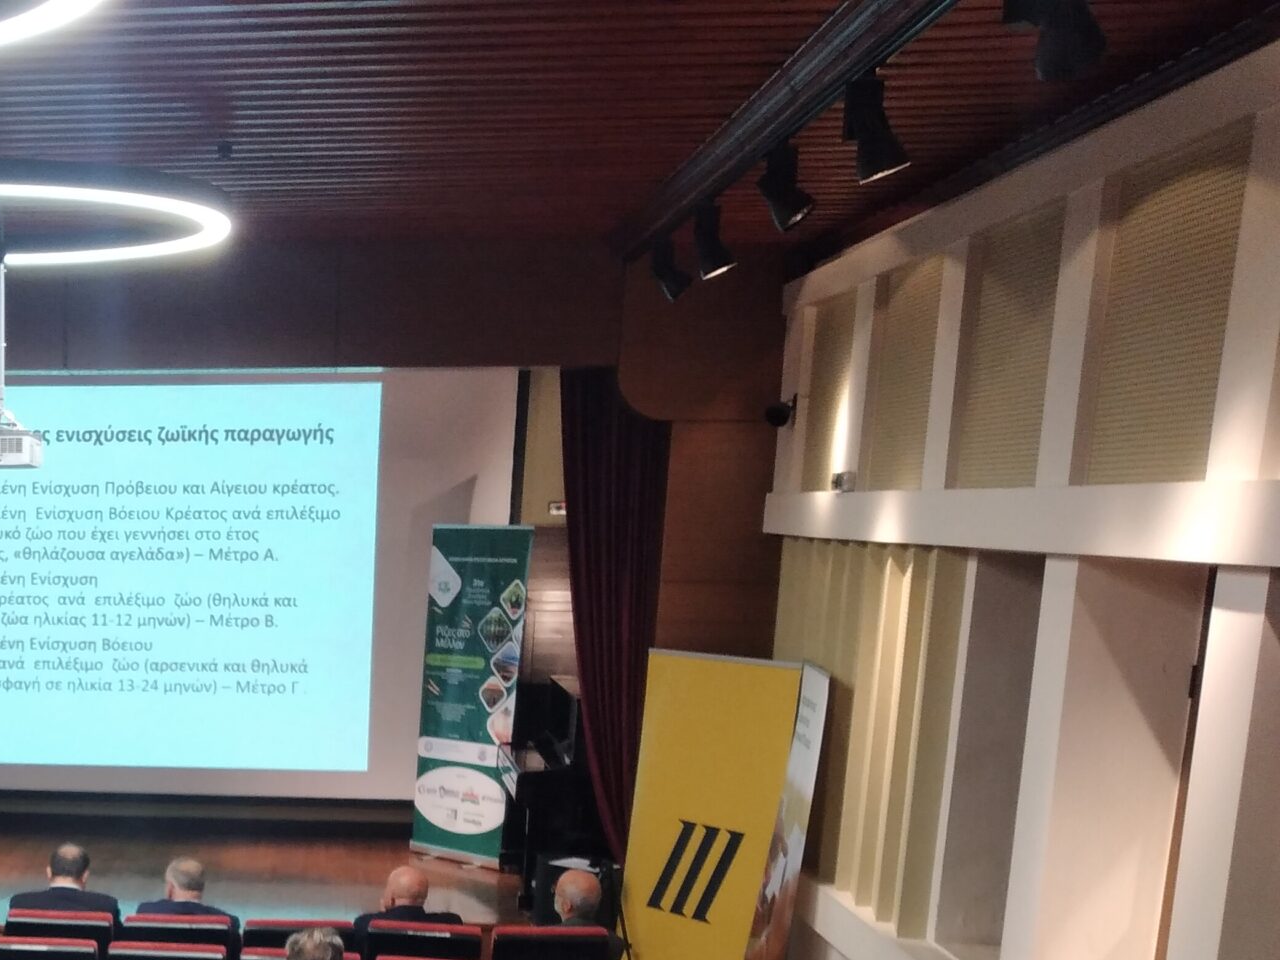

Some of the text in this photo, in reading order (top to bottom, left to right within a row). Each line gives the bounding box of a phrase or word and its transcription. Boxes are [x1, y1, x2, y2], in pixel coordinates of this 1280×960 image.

[56, 425, 152, 445] ενισχύσεις
[157, 424, 219, 445] ζωϊκής
[224, 423, 334, 445] παραγωγής
[32, 480, 99, 497] Ενίσχυση
[105, 480, 177, 497] Πρόβειου
[182, 483, 206, 494] και
[210, 480, 267, 497] Αίγειου
[272, 479, 339, 497] κρέατος.
[35, 506, 103, 523] Ενίσχυση
[108, 506, 160, 521] Βόειου
[166, 505, 228, 522] Κρέατος
[232, 505, 261, 520] ανά
[266, 505, 341, 523] επιλέξιμο
[25, 525, 53, 542] ζώο
[57, 529, 86, 540] που
[91, 526, 119, 543] έχει
[124, 526, 190, 543] γεννήσει
[195, 529, 221, 541] στο
[226, 527, 259, 543] έτος
[14, 546, 105, 563] «θηλάζουσα
[110, 546, 190, 564] αγελάδα»)
[208, 547, 259, 564] Μέτρο
[30, 572, 98, 588] Ενίσχυση
[57, 591, 86, 606] ανά
[94, 592, 165, 609] επιλέξιμο
[174, 593, 202, 608] ζώο
[207, 593, 269, 609] (θηλυκά
[274, 596, 298, 608] και
[1, 611, 28, 626] ζώα
[33, 611, 86, 628] ηλικίας
[92, 613, 133, 626] 11-12
[137, 612, 191, 629] μηνών)
[209, 613, 260, 630] Μέτρο
[29, 636, 97, 653] Ενίσχυση
[102, 637, 153, 652] Βόειου
[34, 656, 103, 673] επιλέξιμο
[112, 657, 139, 672] ζώο
[144, 657, 218, 674] (αρσενικά
[223, 661, 247, 673] και
[251, 658, 308, 675] θηλυκά
[45, 679, 62, 690] σε
[67, 677, 112, 693] ηλικία
[118, 679, 159, 692] 13-24
[163, 679, 217, 695] μηνών)
[236, 680, 286, 696] Μέτρο
